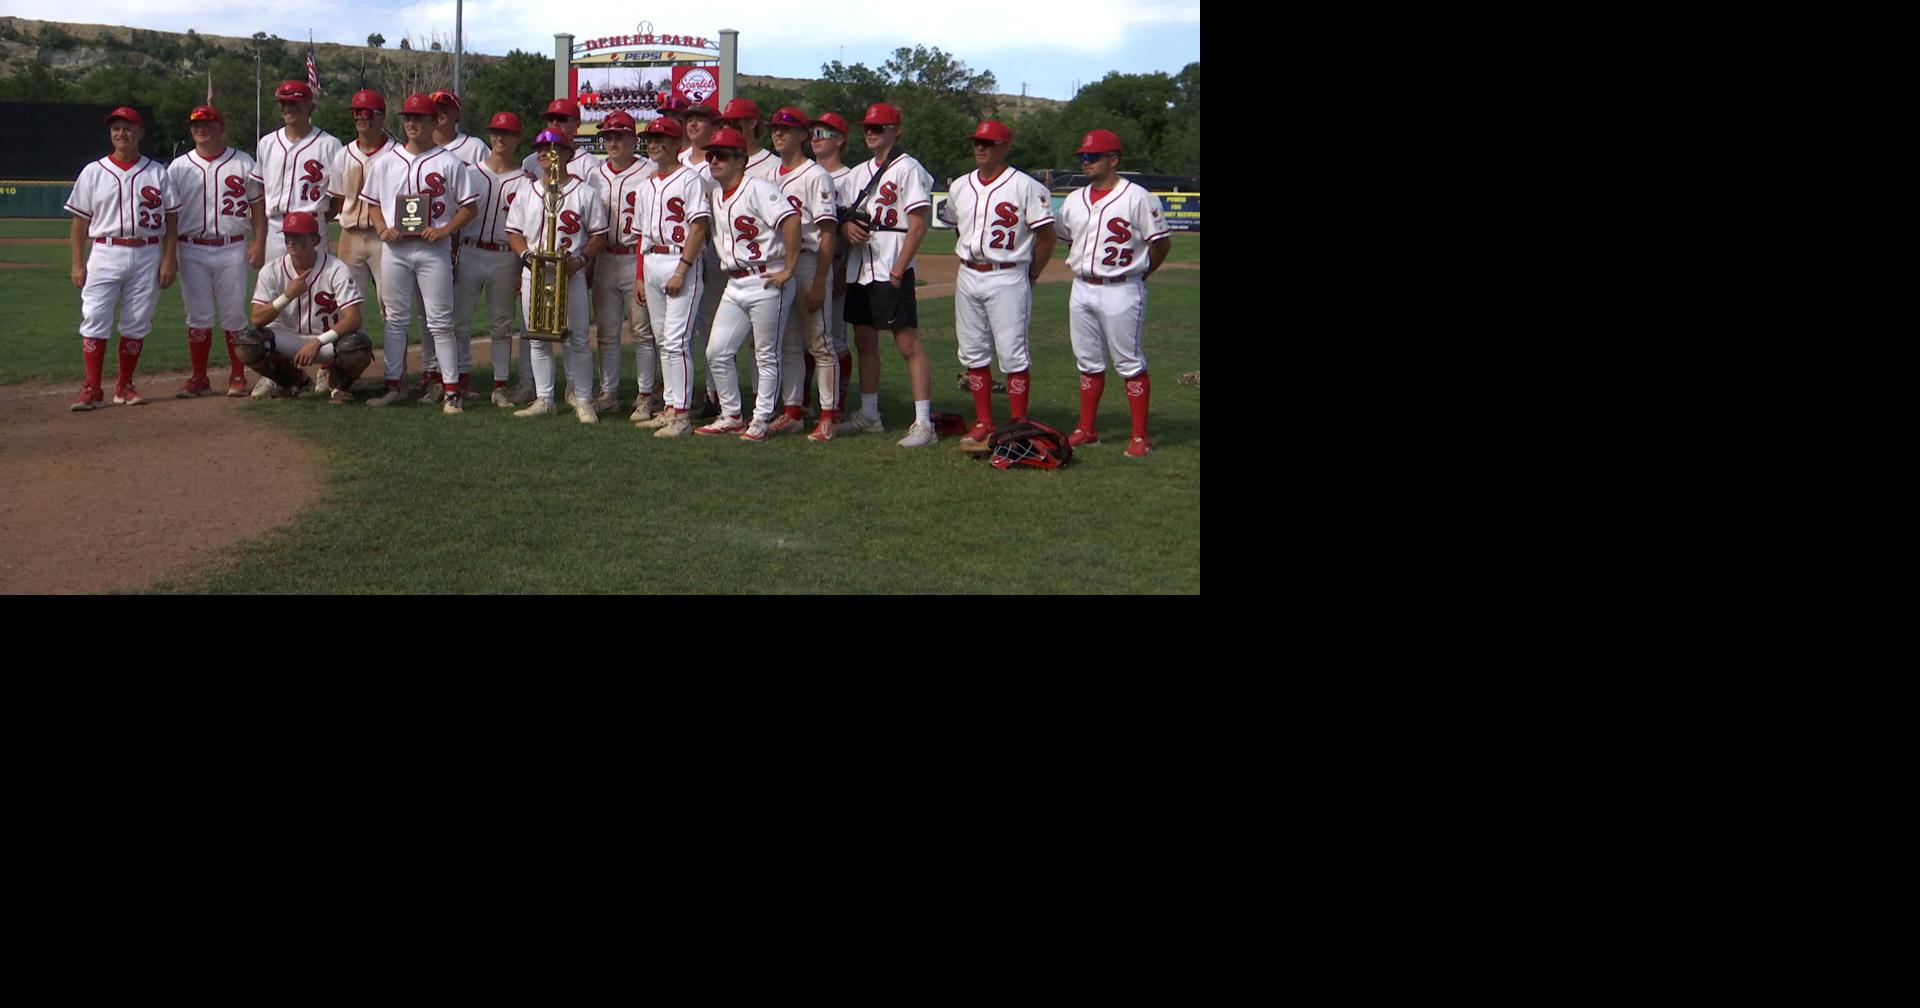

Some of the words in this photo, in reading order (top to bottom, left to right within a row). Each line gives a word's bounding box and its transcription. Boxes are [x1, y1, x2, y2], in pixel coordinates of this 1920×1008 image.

[585, 33, 655, 51] DEHLER
[662, 34, 706, 49] PARK
[624, 52, 662, 61] PEPSI
[677, 78, 716, 91] Scarlets
[299, 159, 324, 183] S
[222, 175, 246, 198] S
[301, 183, 321, 202] 16
[420, 172, 446, 197] S
[875, 180, 897, 206] S
[139, 186, 162, 209] S
[221, 198, 248, 218] 22
[139, 210, 162, 230] 23
[432, 201, 446, 219] 9
[665, 197, 685, 223] S
[873, 206, 898, 227] 18
[991, 201, 1019, 228] S
[557, 210, 580, 235] S
[623, 216, 632, 234] 1
[734, 215, 759, 243] S
[1103, 217, 1132, 244] S
[671, 225, 685, 243] 8
[989, 229, 1016, 251] 21
[746, 241, 762, 260] 3
[1102, 246, 1134, 267] 25
[314, 291, 338, 316] S
